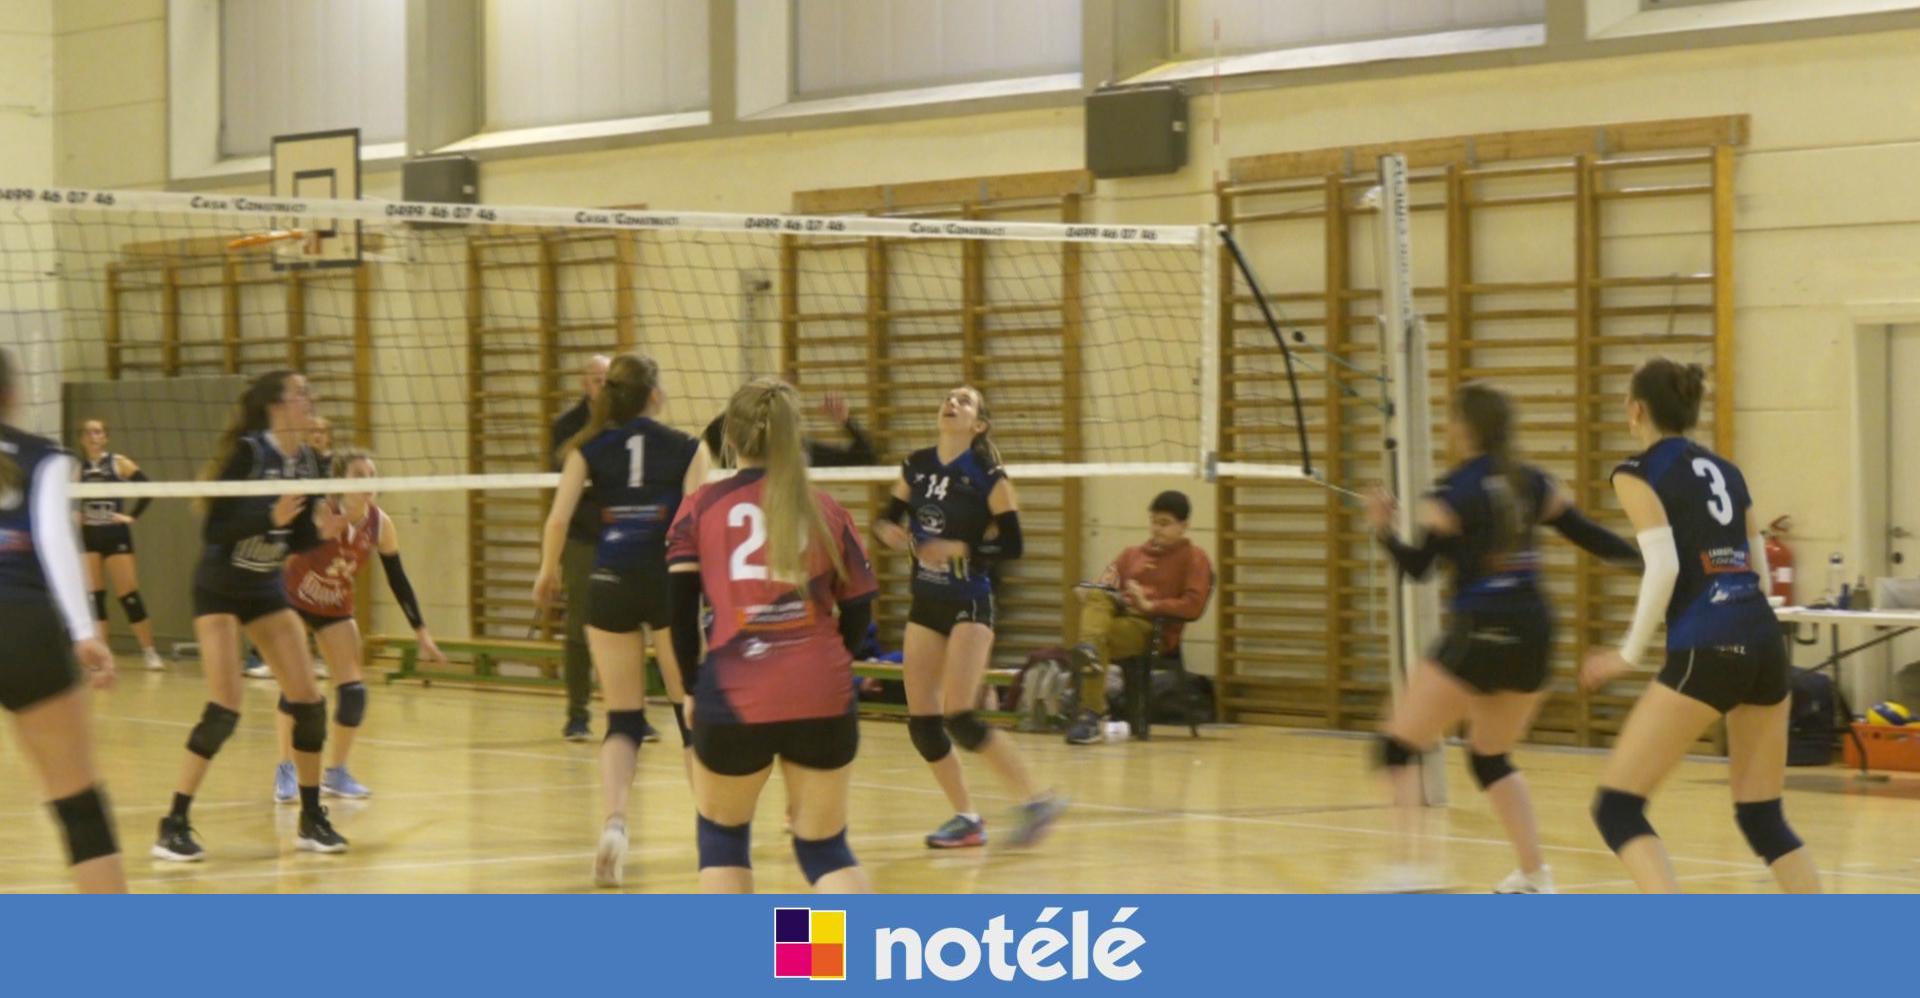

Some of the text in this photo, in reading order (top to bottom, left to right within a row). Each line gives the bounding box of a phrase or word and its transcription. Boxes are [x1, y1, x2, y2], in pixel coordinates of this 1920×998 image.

[0, 187, 115, 206] 499 46 07 46
[624, 433, 645, 488] 1
[925, 473, 950, 501] 14
[1692, 457, 1733, 526] 3
